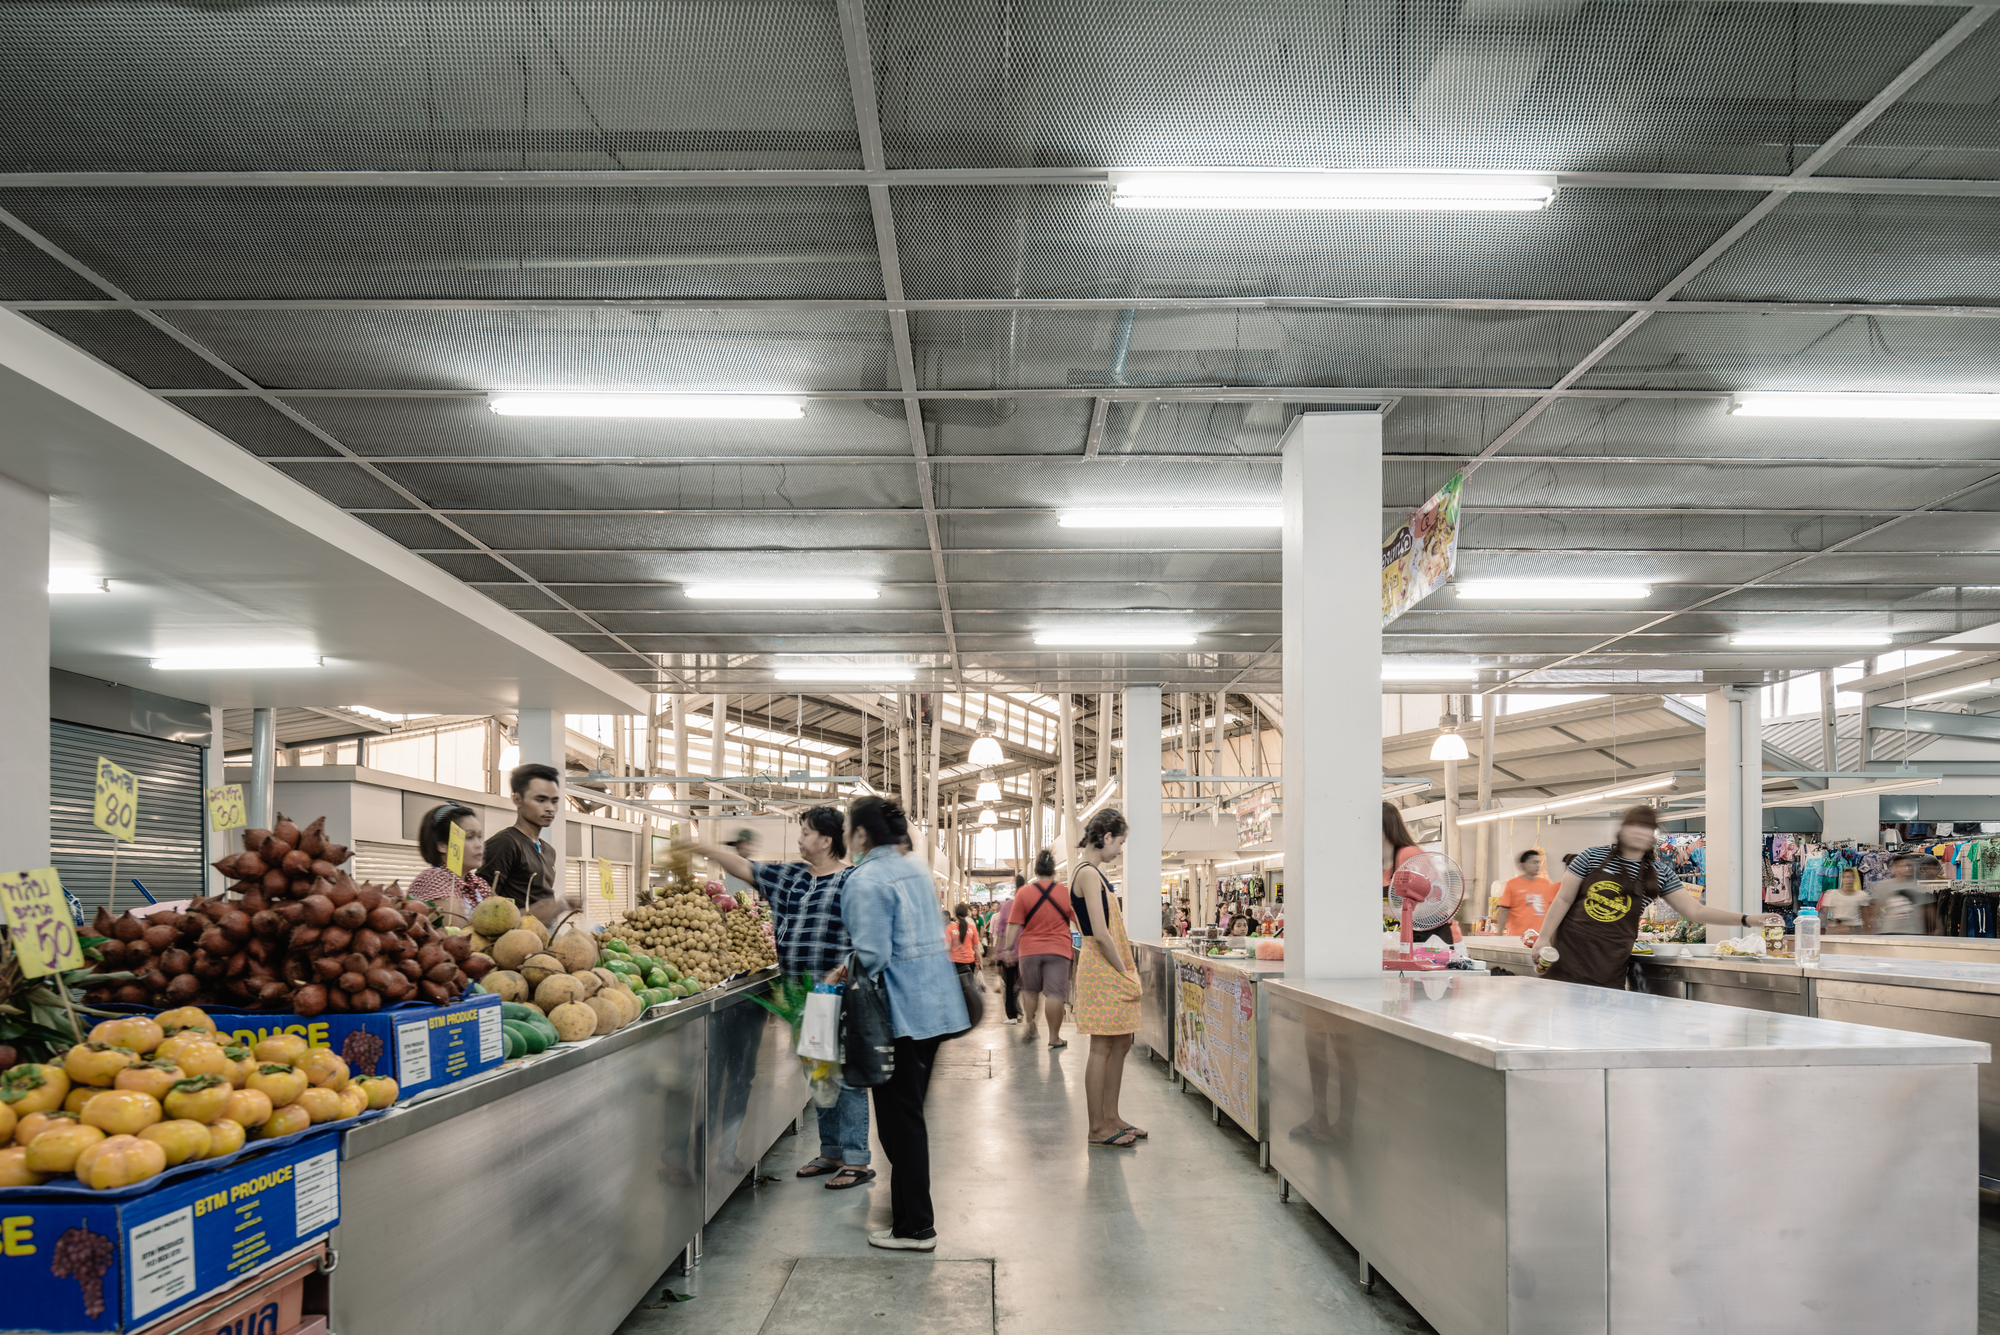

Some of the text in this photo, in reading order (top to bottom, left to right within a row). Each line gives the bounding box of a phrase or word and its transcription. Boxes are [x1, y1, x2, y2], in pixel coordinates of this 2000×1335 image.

[105, 793, 132, 828] 80
[217, 805, 240, 827] 30
[36, 918, 73, 969] 50
[428, 1015, 446, 1030] BTM
[446, 1009, 478, 1026] PRODUCE
[194, 1190, 228, 1217] BTM
[230, 1165, 293, 1203] PRODUCE
[235, 1200, 260, 1215] PRODUCE
[243, 1211, 252, 1220] OF
[234, 1216, 262, 1233] AUSTRALIA
